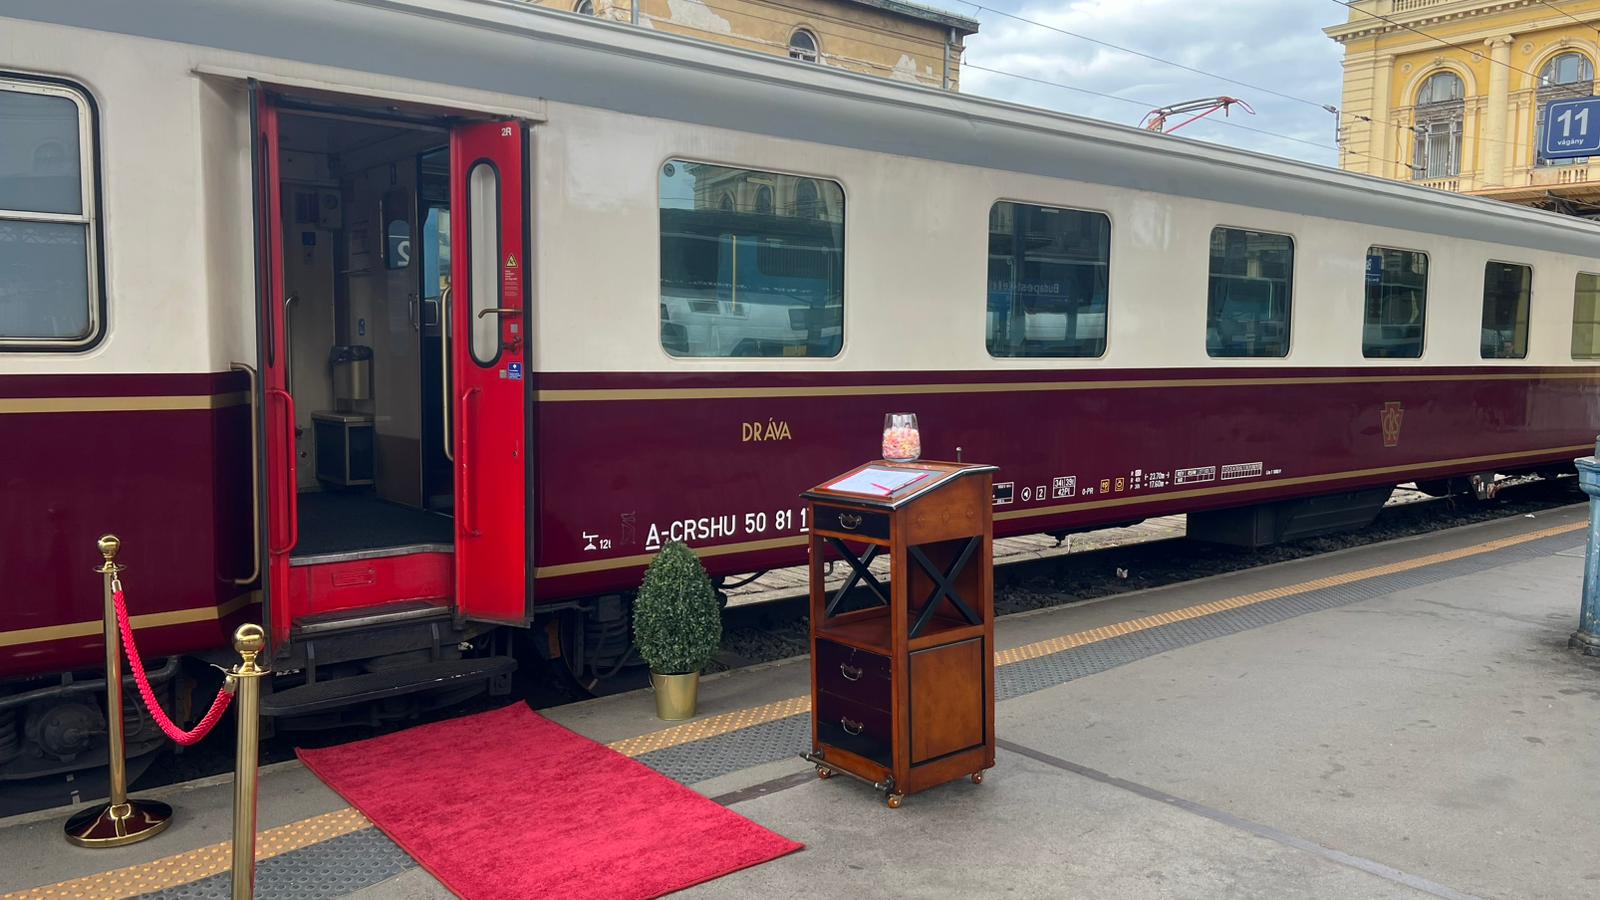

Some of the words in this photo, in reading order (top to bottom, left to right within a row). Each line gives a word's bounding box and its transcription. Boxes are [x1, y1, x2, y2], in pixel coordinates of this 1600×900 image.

[501, 127, 512, 137] 2R
[1557, 107, 1589, 137] 11
[1557, 137, 1584, 146] vágány
[742, 417, 792, 442] DRÁVA
[645, 514, 736, 551] A-CRSHU
[745, 512, 767, 534] 50
[775, 509, 792, 530] 81
